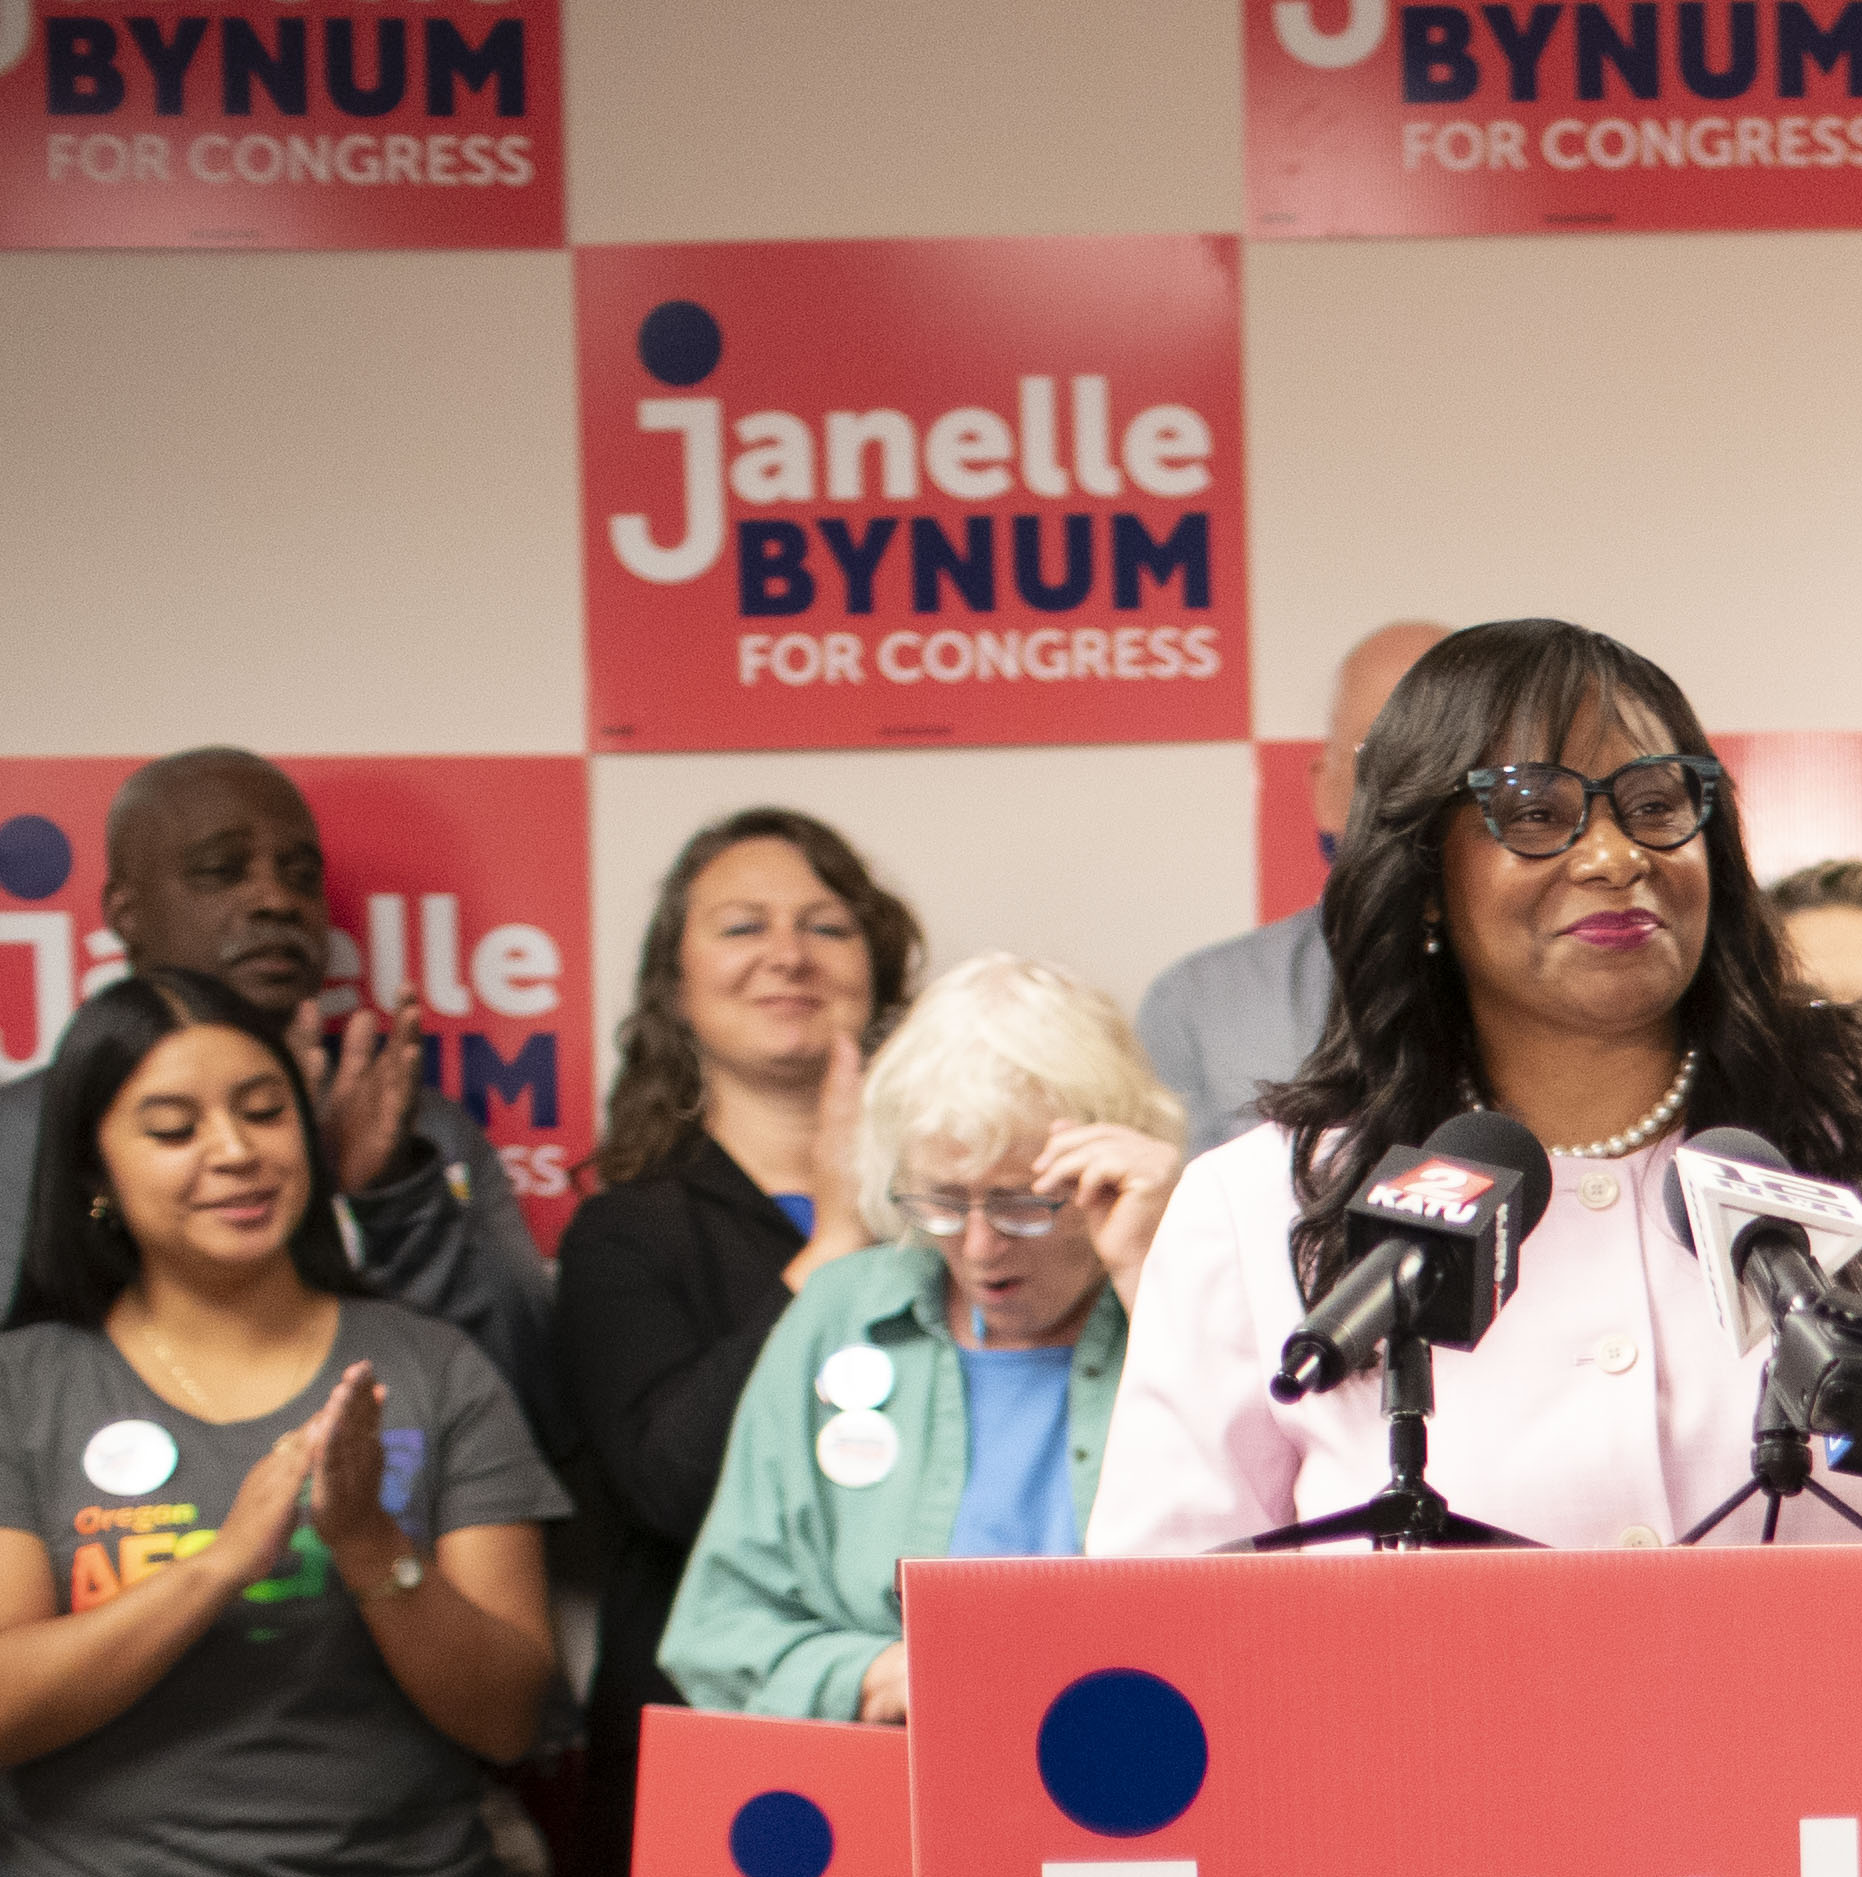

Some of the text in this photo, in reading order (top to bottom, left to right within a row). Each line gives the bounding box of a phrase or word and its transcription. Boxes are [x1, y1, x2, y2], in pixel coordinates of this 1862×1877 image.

[45, 15, 527, 118] BYNUM
[46, 133, 534, 188] FOR CONGRESS
[1402, 118, 1527, 171] FOR
[734, 512, 1214, 618] BYNUM
[738, 627, 1220, 688] FOR CONGRESS
[1366, 1184, 1478, 1225] KATU
[1403, 1167, 1468, 1200] 2
[74, 1503, 199, 1537] Oregon
